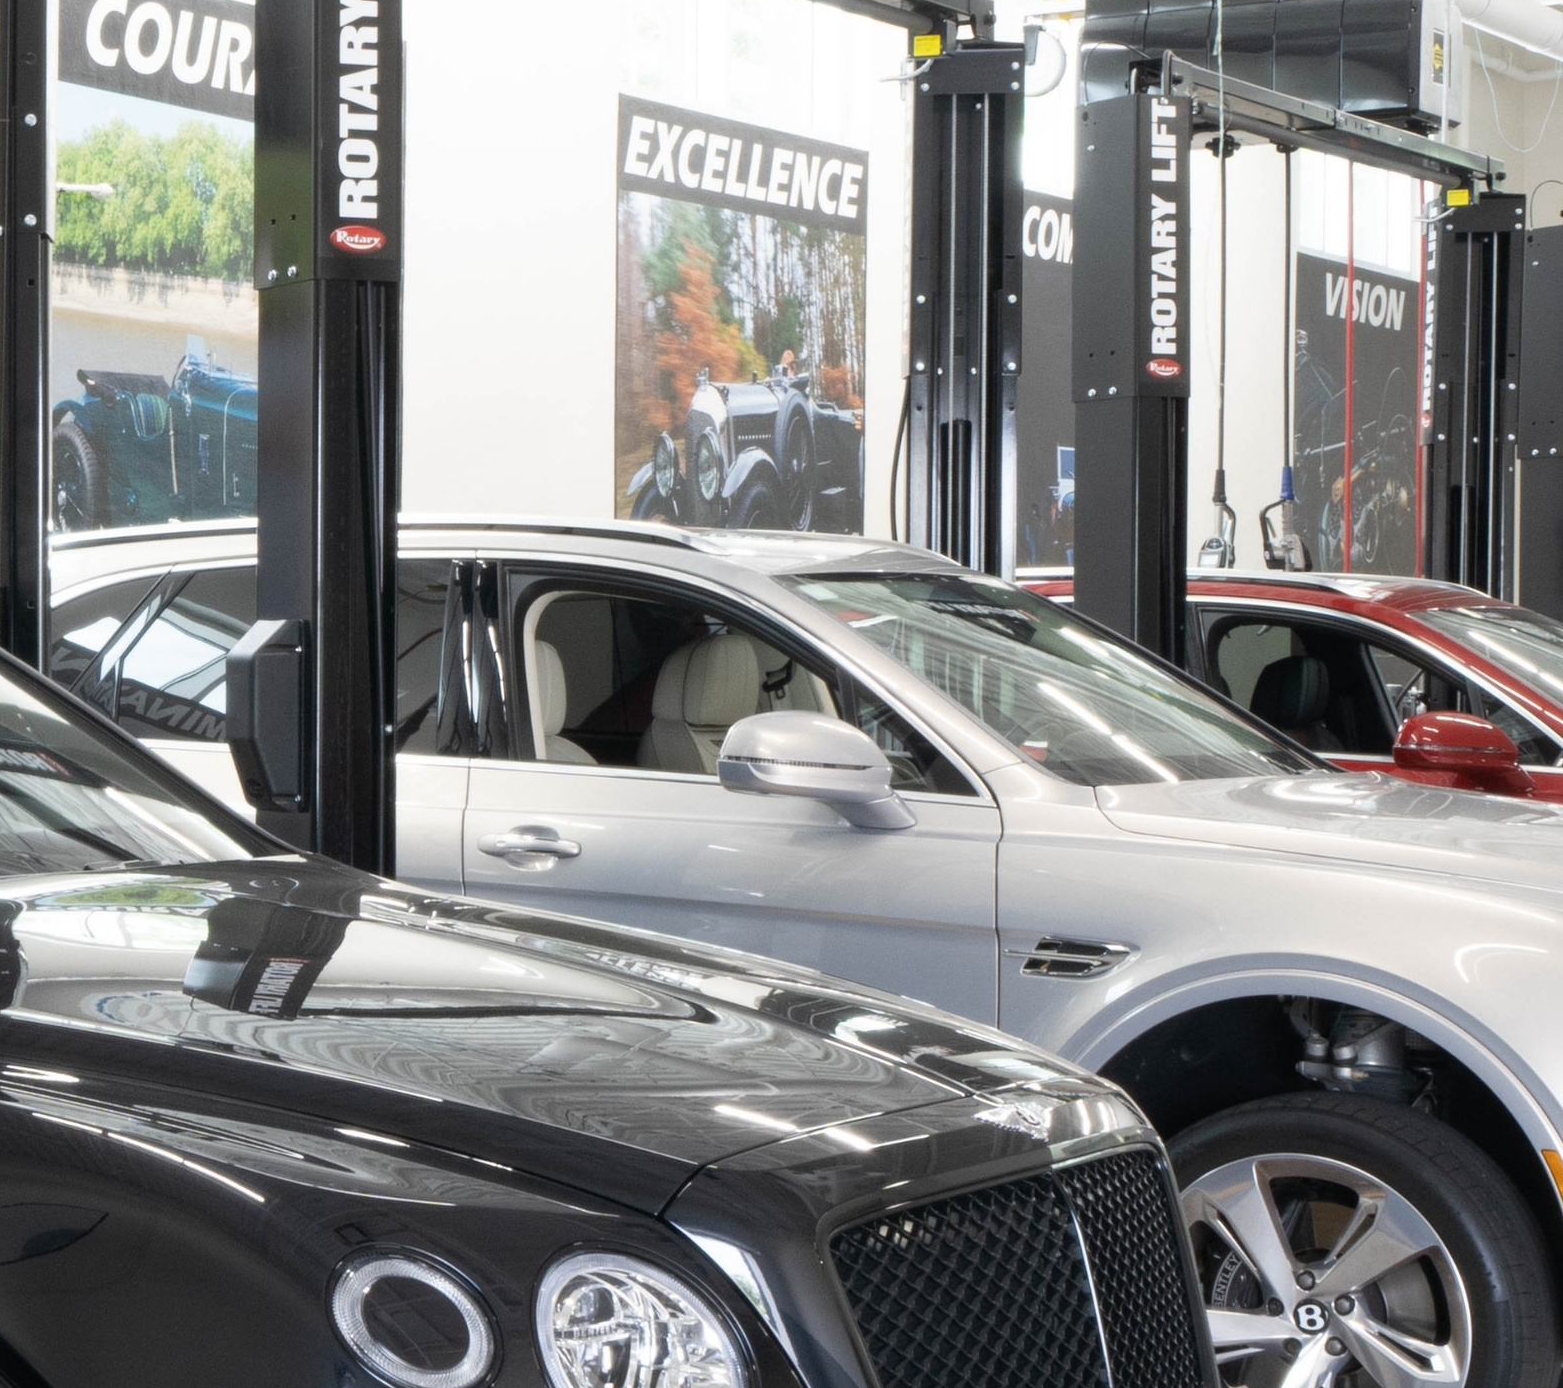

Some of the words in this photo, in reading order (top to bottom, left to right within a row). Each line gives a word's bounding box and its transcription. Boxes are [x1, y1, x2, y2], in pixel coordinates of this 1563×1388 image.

[623, 116, 864, 219] EXCELLENCE
[1152, 97, 1177, 182] LIFT
[336, 230, 380, 247] Rotary
[1151, 194, 1176, 354] ROTARY
[1326, 272, 1407, 331] VISION
